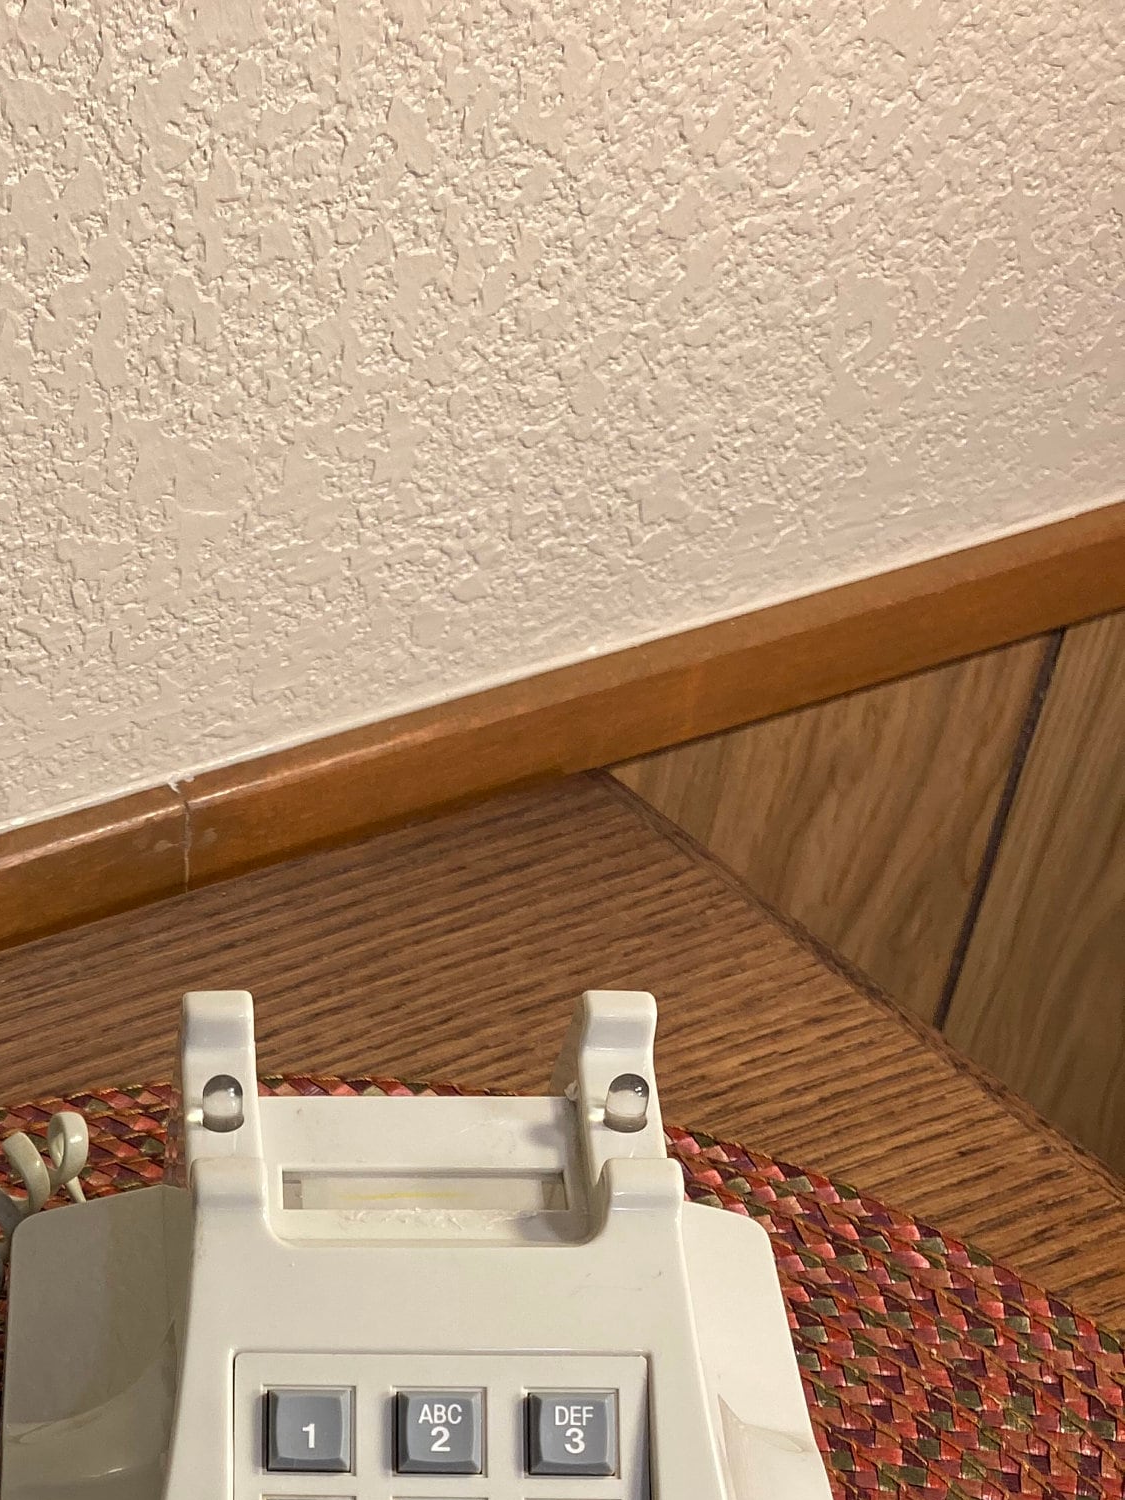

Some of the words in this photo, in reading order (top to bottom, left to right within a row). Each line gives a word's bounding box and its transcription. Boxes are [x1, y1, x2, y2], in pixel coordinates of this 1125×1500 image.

[418, 1403, 462, 1425] ABC
[554, 1405, 594, 1426] DEF
[302, 1423, 315, 1449] 1
[430, 1425, 451, 1452] 2
[564, 1427, 585, 1454] 3
